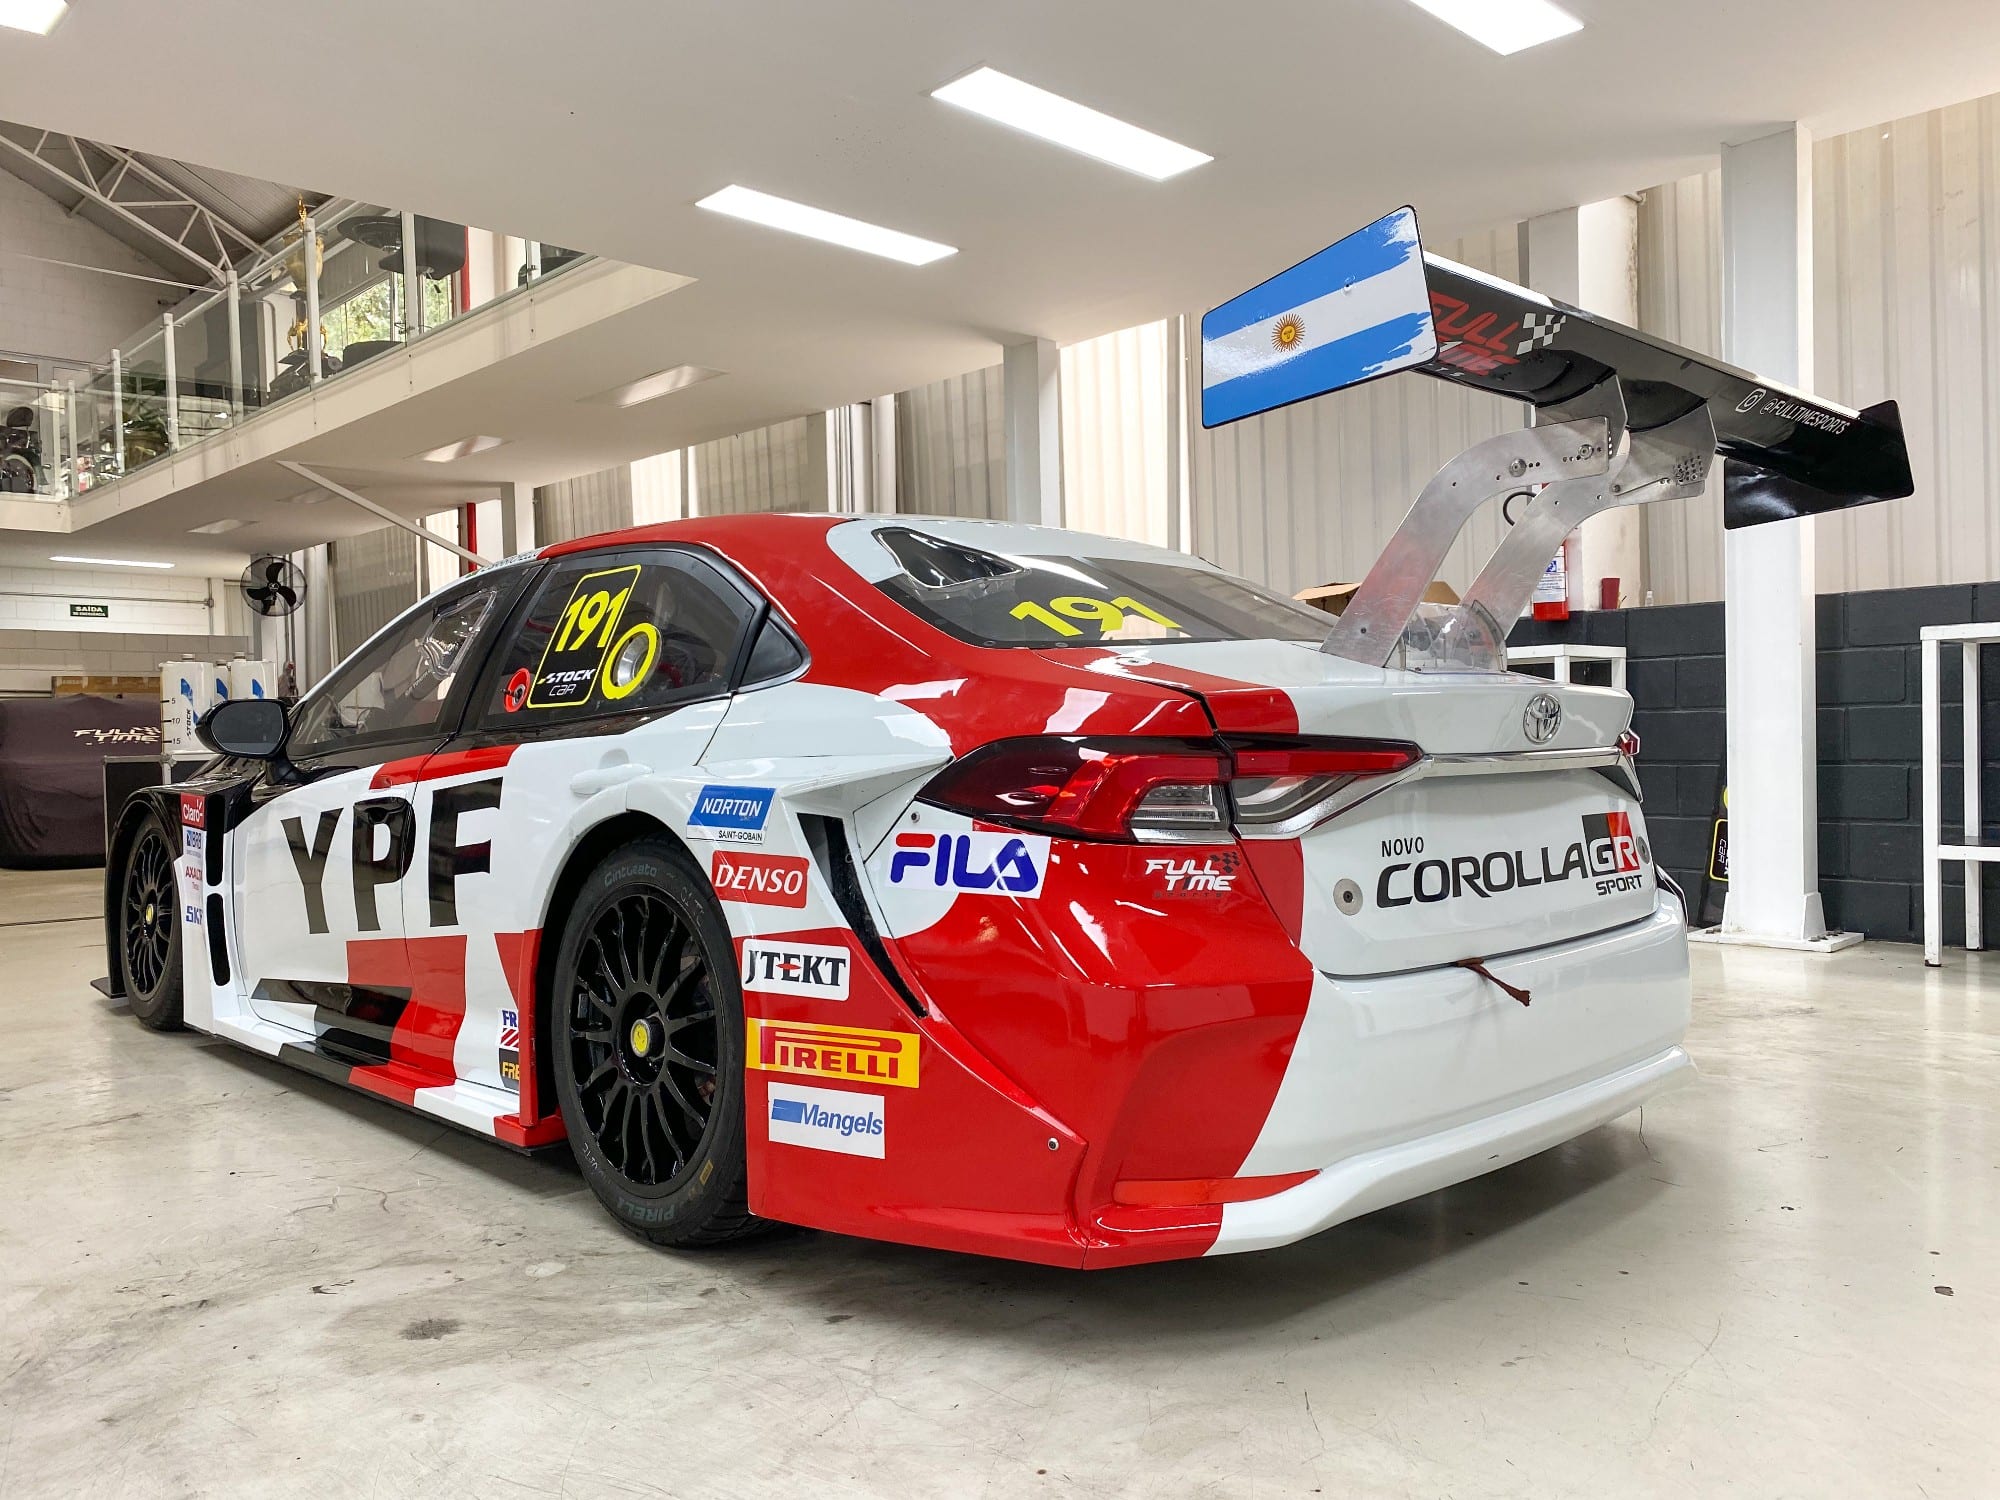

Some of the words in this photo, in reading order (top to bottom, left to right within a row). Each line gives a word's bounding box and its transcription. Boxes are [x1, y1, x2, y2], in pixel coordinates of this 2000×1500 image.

[1760, 398, 1850, 435] @FULLTIMESPORTS
[555, 587, 629, 652] 191
[1009, 596, 1184, 637] 191
[541, 669, 596, 684] STOCK
[172, 717, 180, 725] 10
[183, 803, 200, 822] Claro
[701, 798, 762, 817] NORTON
[718, 830, 762, 841] SAINT-GOBAIN
[1381, 836, 1424, 858] NOVO
[280, 776, 503, 934] YPF
[890, 832, 1039, 892] FILA
[1145, 859, 1220, 875] FULL
[715, 864, 803, 895] DENSO
[1376, 842, 1588, 909] COROLLA
[1589, 836, 1639, 873] GR
[1596, 874, 1642, 896] SPORT
[745, 950, 847, 987] JTEKT
[760, 1026, 902, 1079] PIRELLI
[801, 1103, 883, 1137] Mangels
